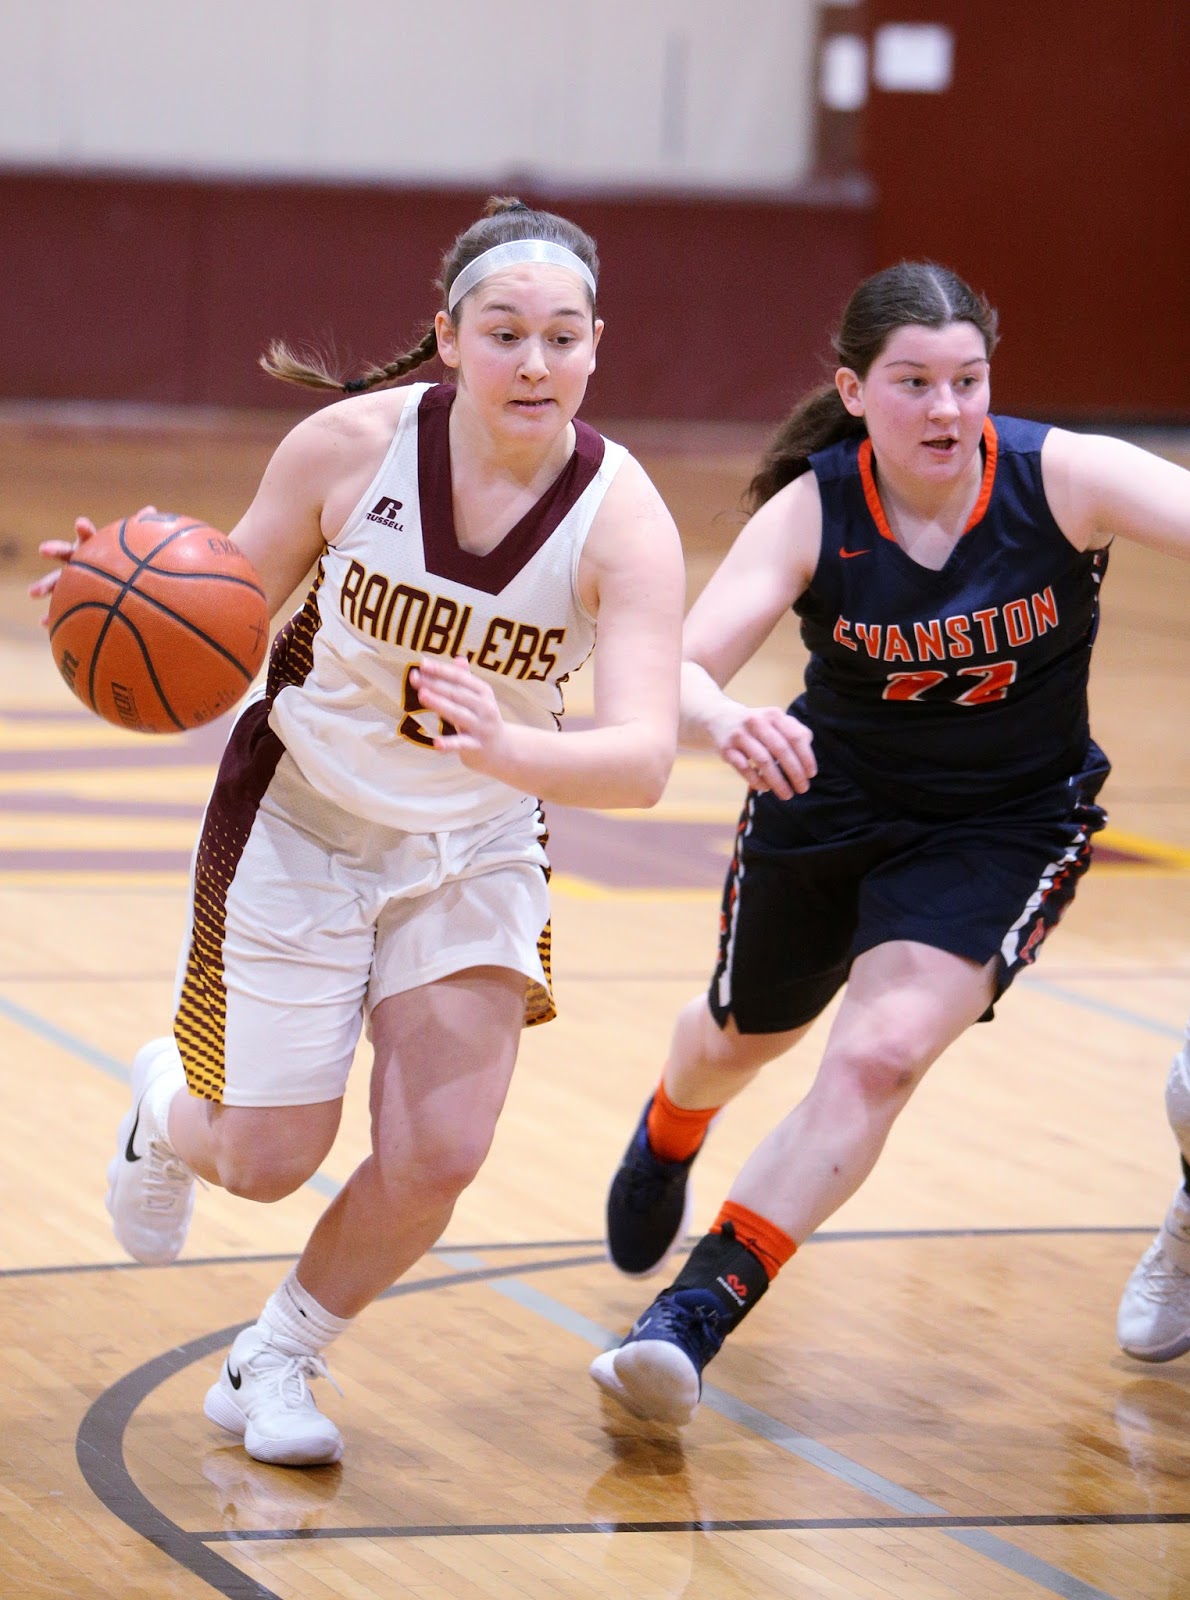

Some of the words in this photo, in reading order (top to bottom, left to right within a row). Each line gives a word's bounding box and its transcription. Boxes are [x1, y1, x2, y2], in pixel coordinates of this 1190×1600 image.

[365, 512, 404, 532] RUSSELL
[340, 560, 567, 682] RAMBLERS
[833, 586, 1059, 662] EVANSTON
[881, 660, 1018, 706] 22
